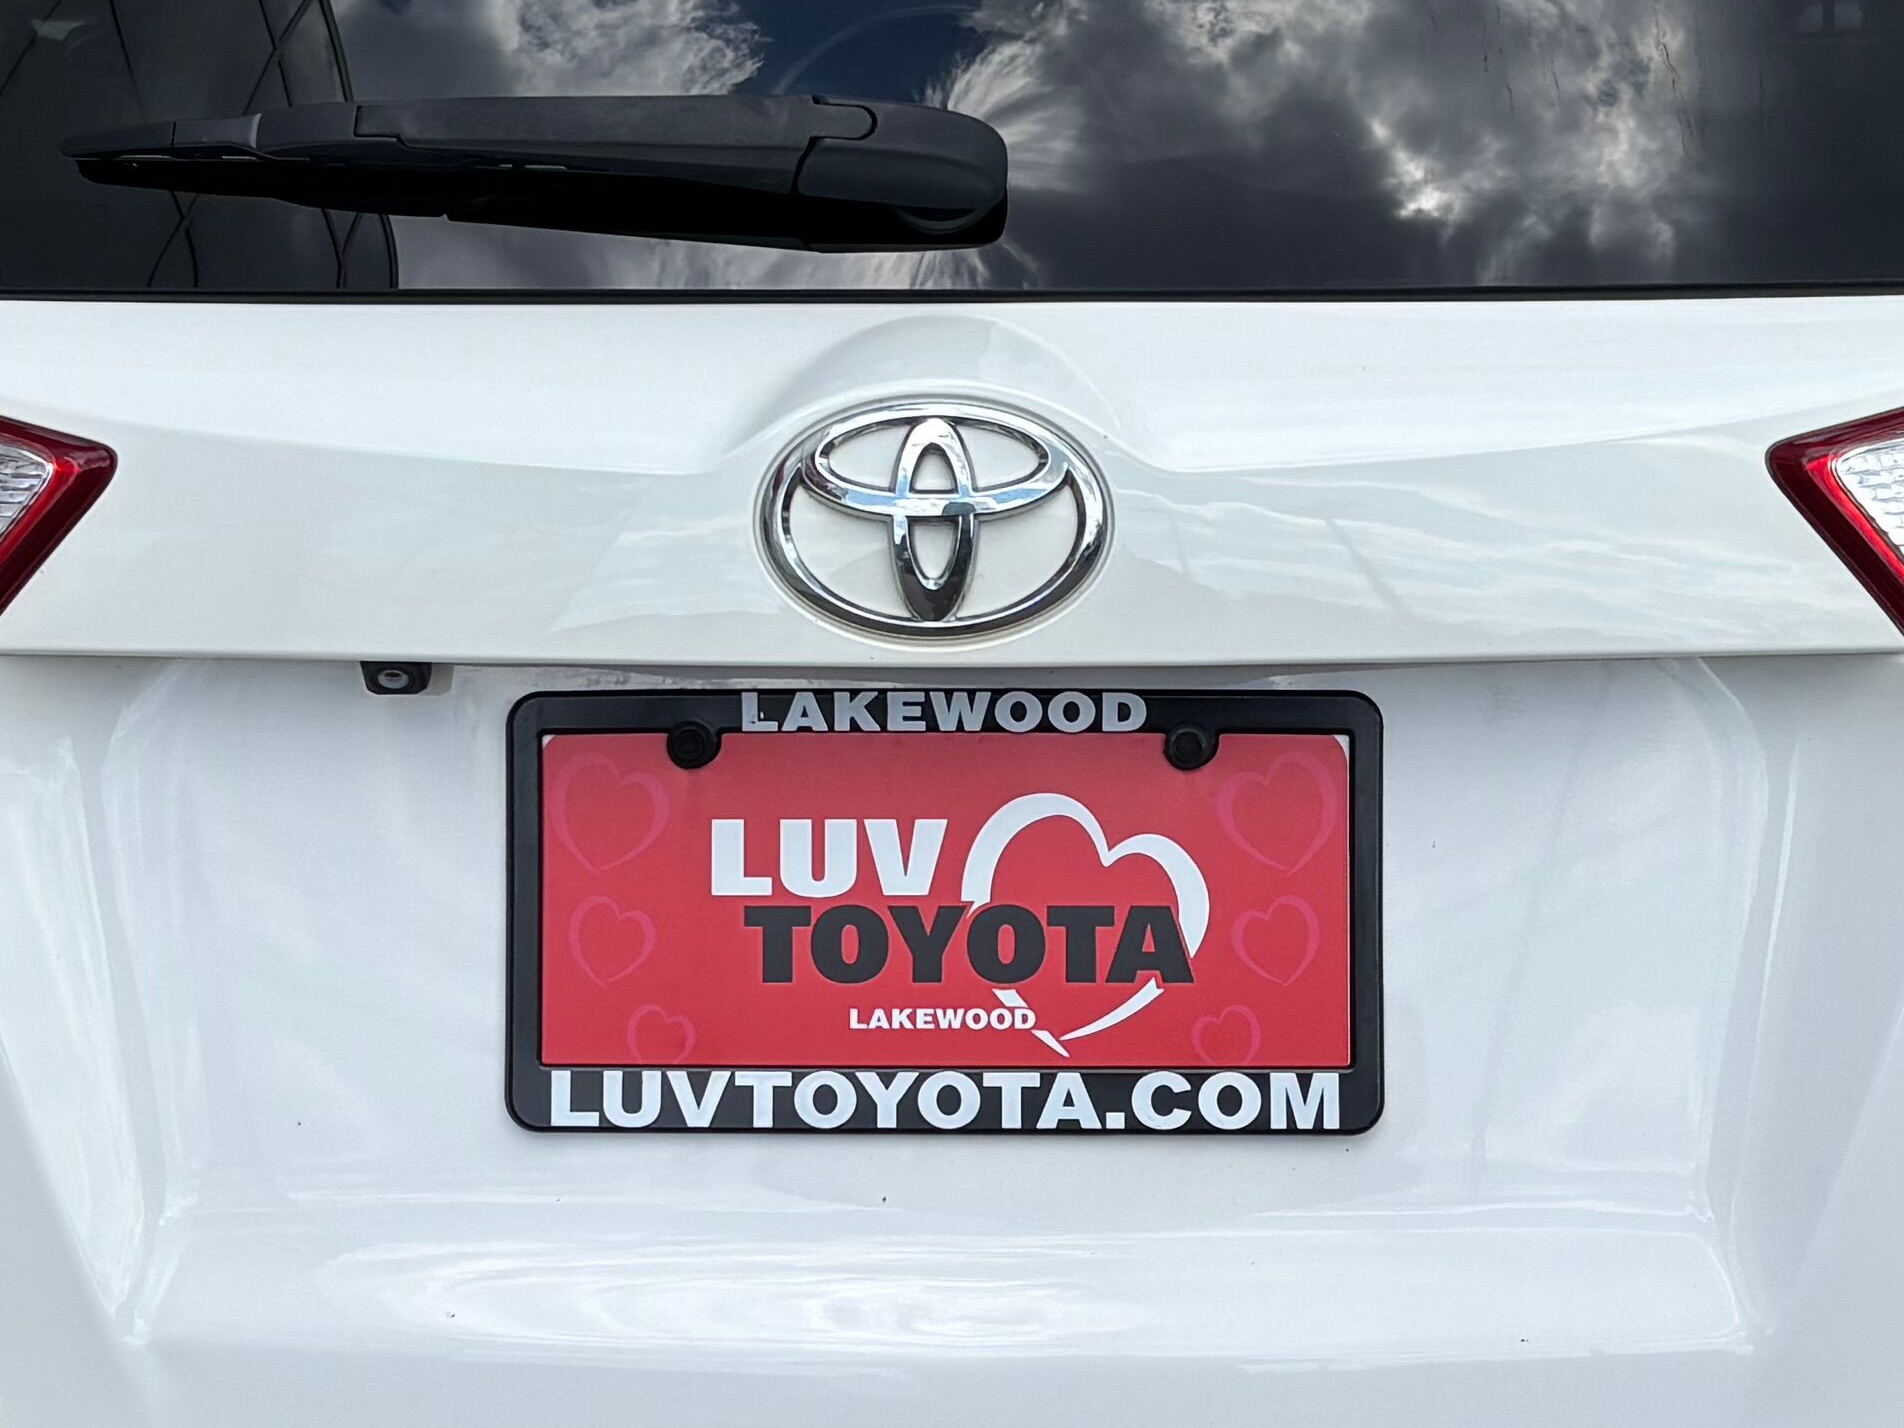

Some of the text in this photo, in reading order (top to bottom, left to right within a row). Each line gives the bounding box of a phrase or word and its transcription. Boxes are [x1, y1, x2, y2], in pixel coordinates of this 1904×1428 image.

[740, 691, 1148, 733] LAKEWOOD
[710, 818, 947, 897] LUV
[744, 904, 1193, 984] TOYOTA
[849, 1007, 1037, 1031] LAKEWOOD
[550, 1070, 1341, 1130] LUVTOYOTA.COM
